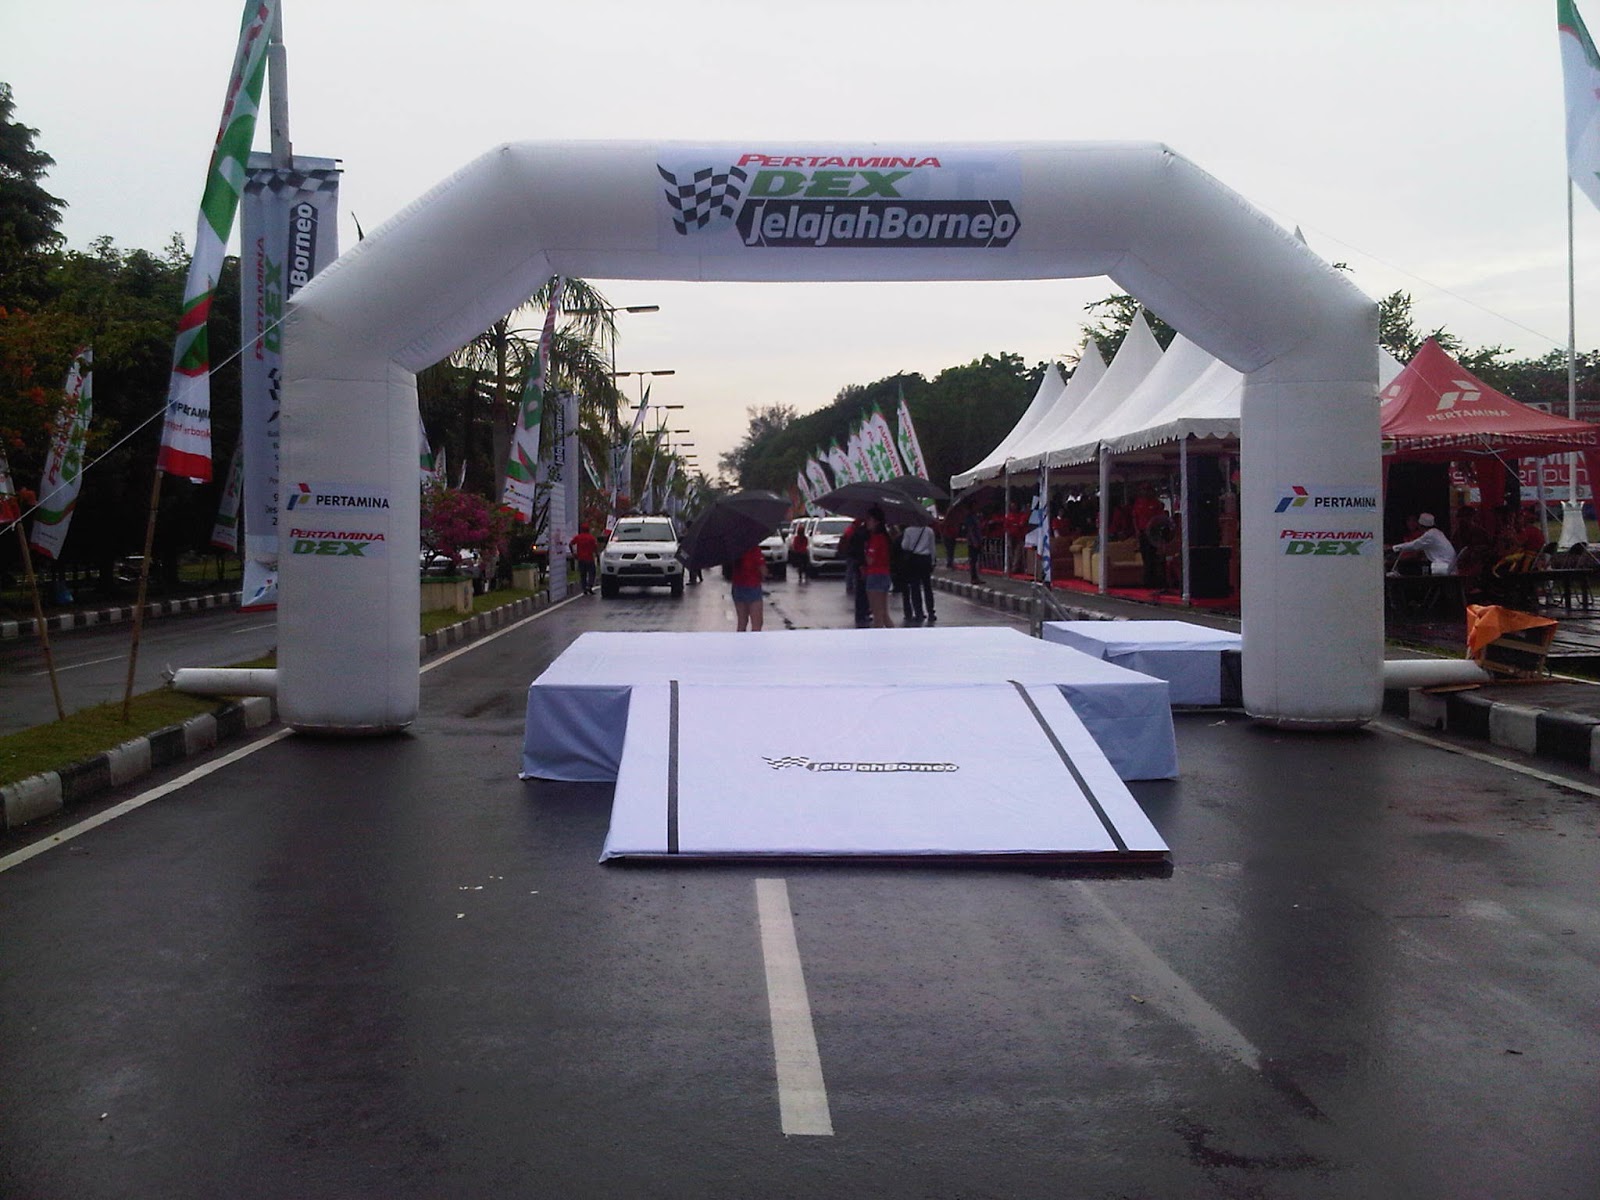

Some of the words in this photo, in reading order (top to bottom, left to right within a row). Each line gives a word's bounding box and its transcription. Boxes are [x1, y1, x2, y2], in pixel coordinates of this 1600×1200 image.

[737, 154, 942, 168] PERTAMINA
[747, 170, 912, 198] DEX
[746, 206, 1017, 247] JelajahBorneo
[256, 237, 265, 362] PERTAMINA
[264, 254, 282, 354] DEX
[1426, 409, 1510, 422] PERTAMINA
[1399, 432, 1504, 450] PERTAMINA
[316, 495, 390, 508] PERTAMINA
[1314, 497, 1376, 508] PERTAMINA
[290, 529, 385, 541] PERTAMINA
[1280, 530, 1374, 540] PERTAMINA
[293, 540, 370, 556] DEX
[1285, 541, 1364, 556] DEX
